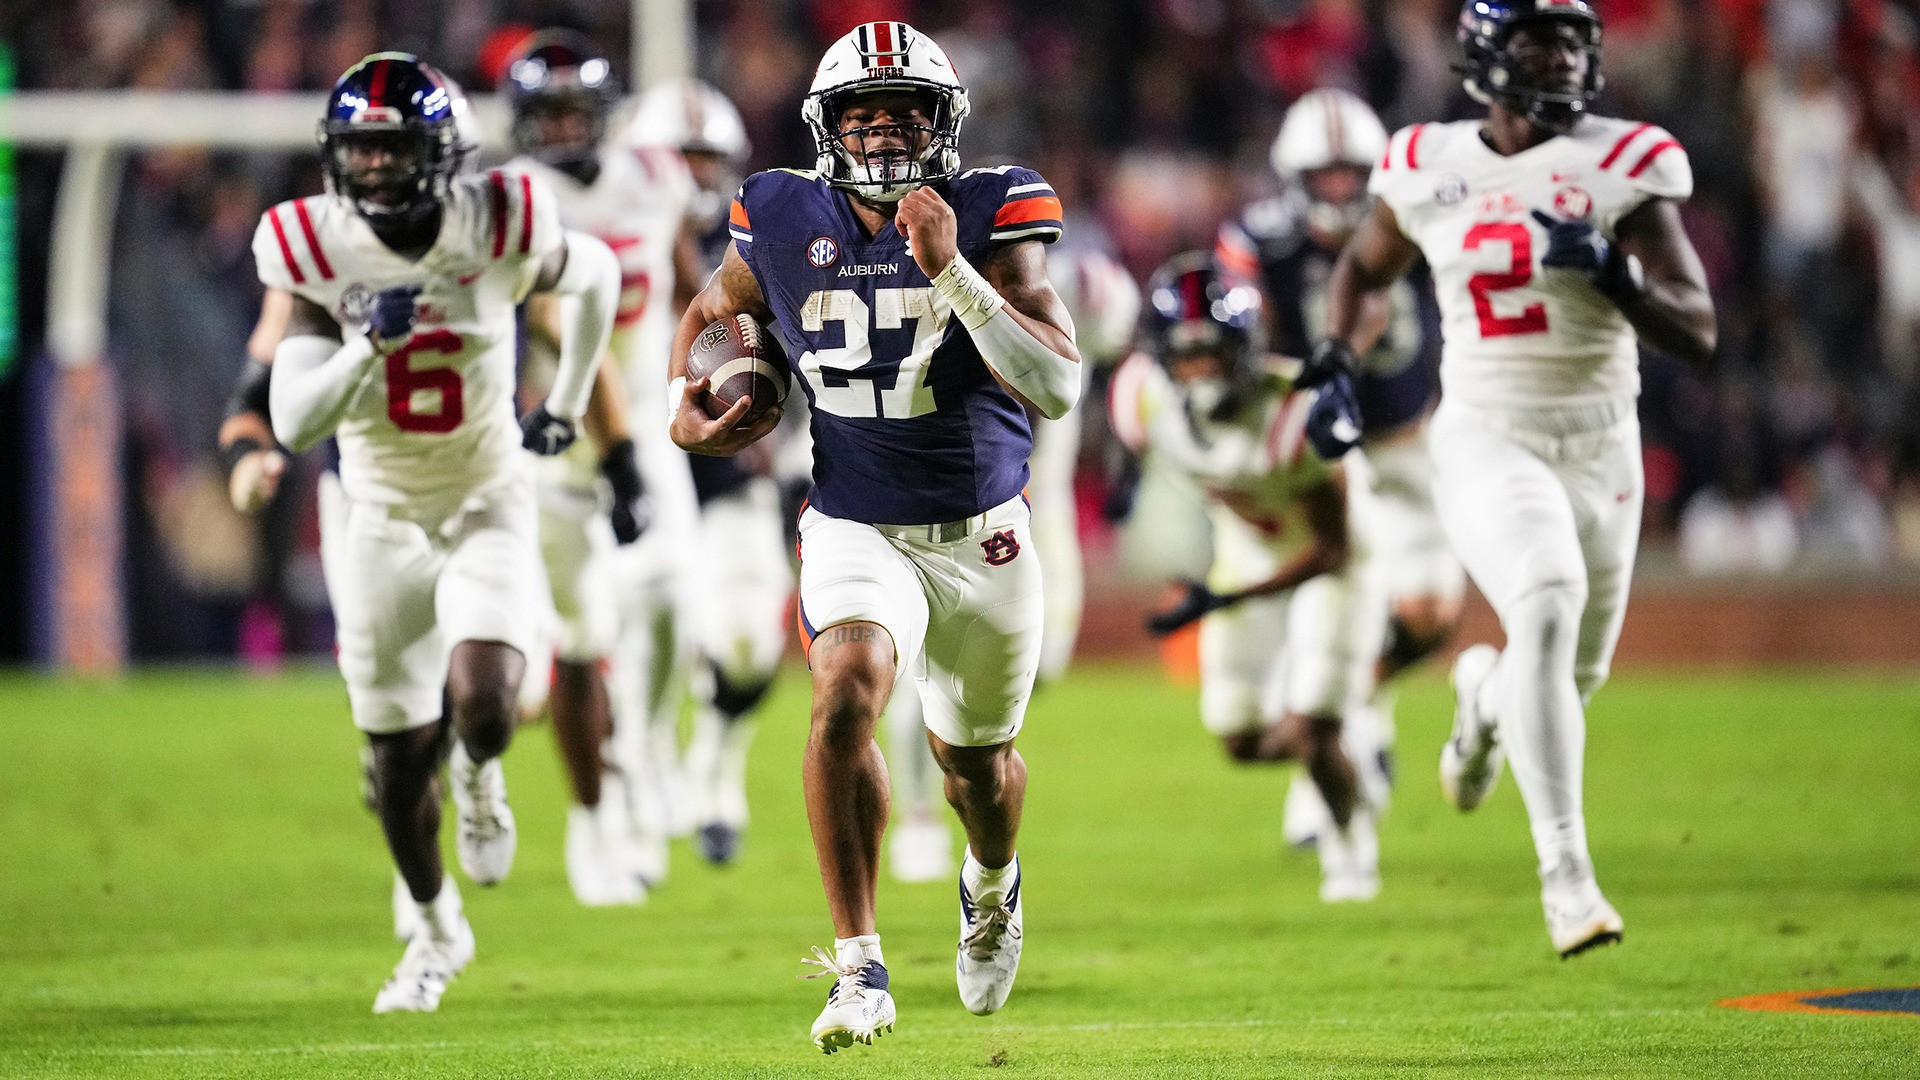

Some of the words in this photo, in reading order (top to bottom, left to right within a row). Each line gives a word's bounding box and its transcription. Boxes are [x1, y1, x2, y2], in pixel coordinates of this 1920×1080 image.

[867, 67, 904, 78] TIGERS
[810, 239, 836, 266] SEC
[837, 262, 899, 278] AUBURN
[1463, 222, 1548, 338] 2
[386, 328, 464, 433] 6
[799, 286, 953, 419] 27
